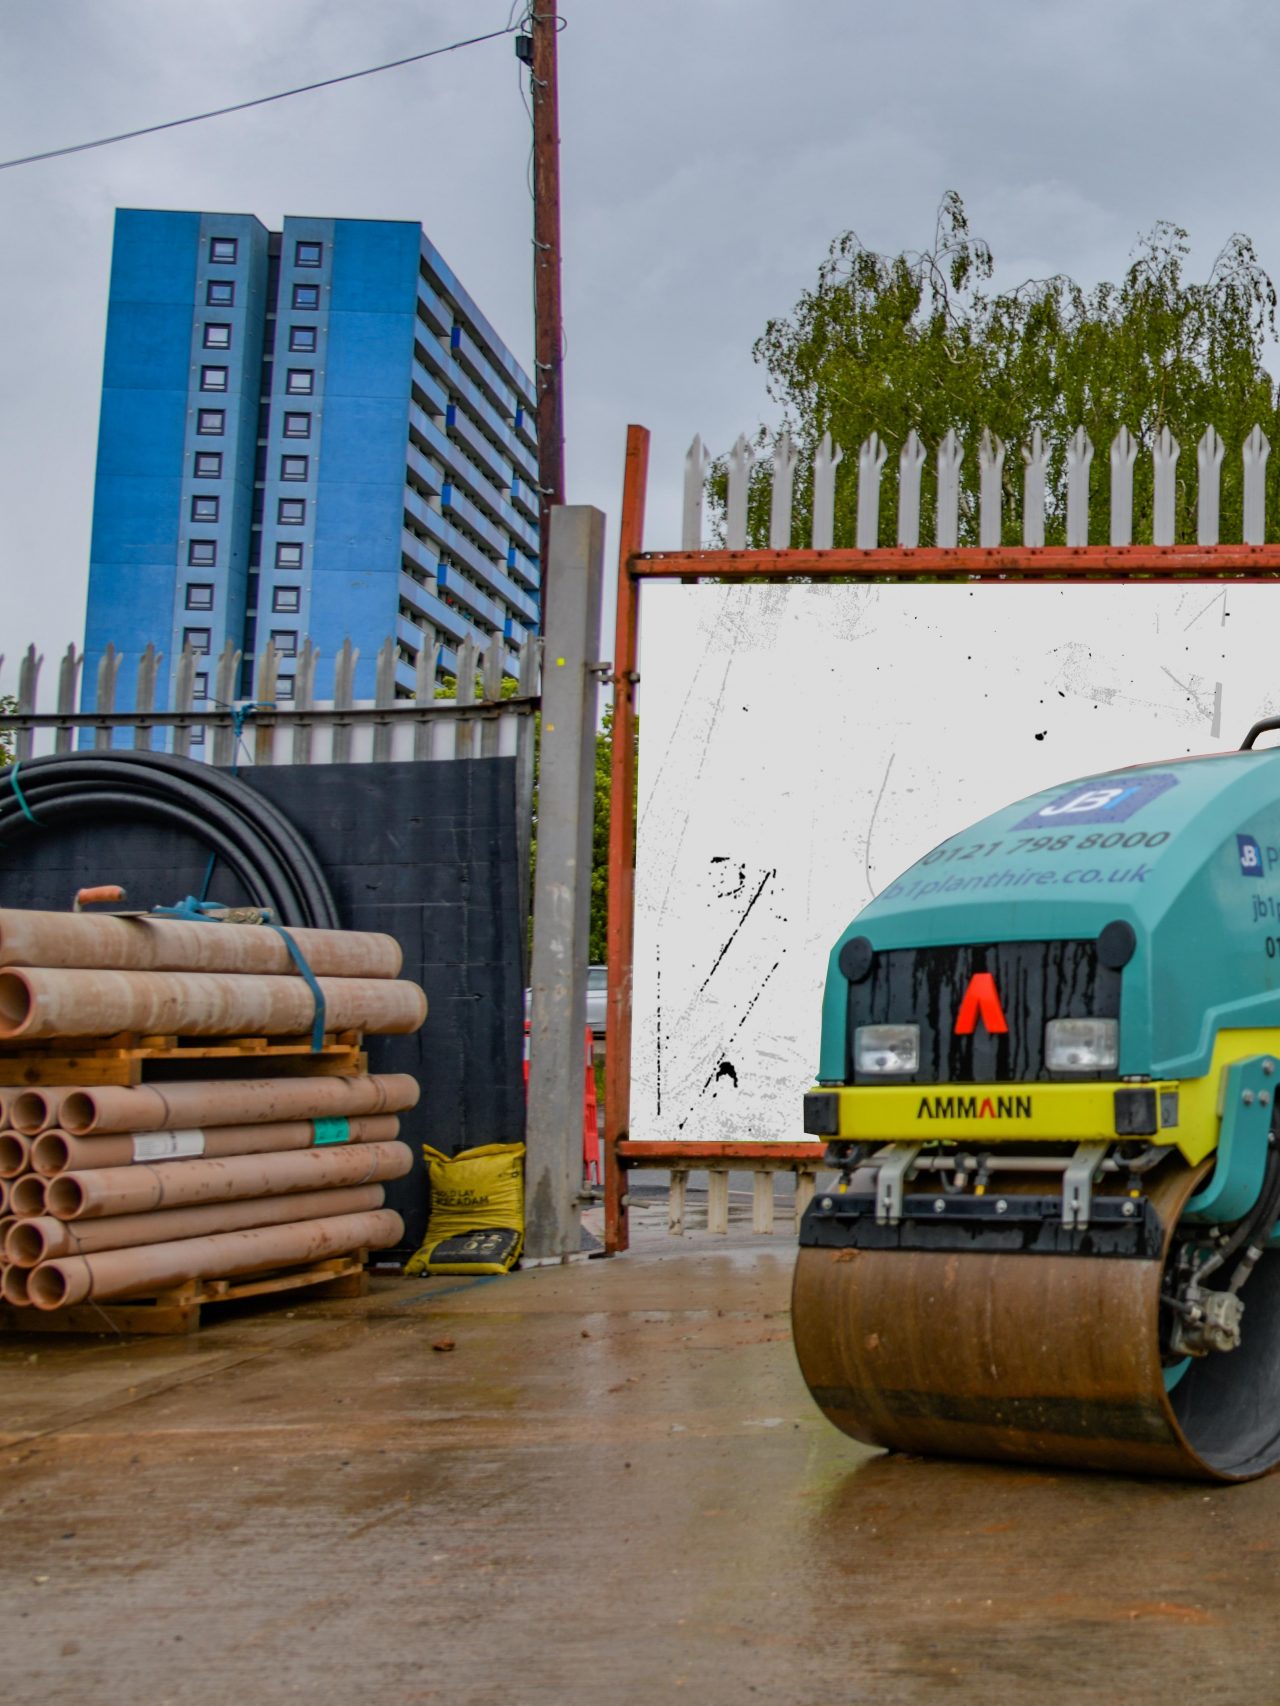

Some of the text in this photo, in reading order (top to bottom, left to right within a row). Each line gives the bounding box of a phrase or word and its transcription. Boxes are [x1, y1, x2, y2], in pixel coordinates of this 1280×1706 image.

[922, 831, 1171, 866] 0121 798 8000
[881, 864, 1154, 901] b1planthire.co.uk
[917, 1096, 1032, 1119] AMMANN
